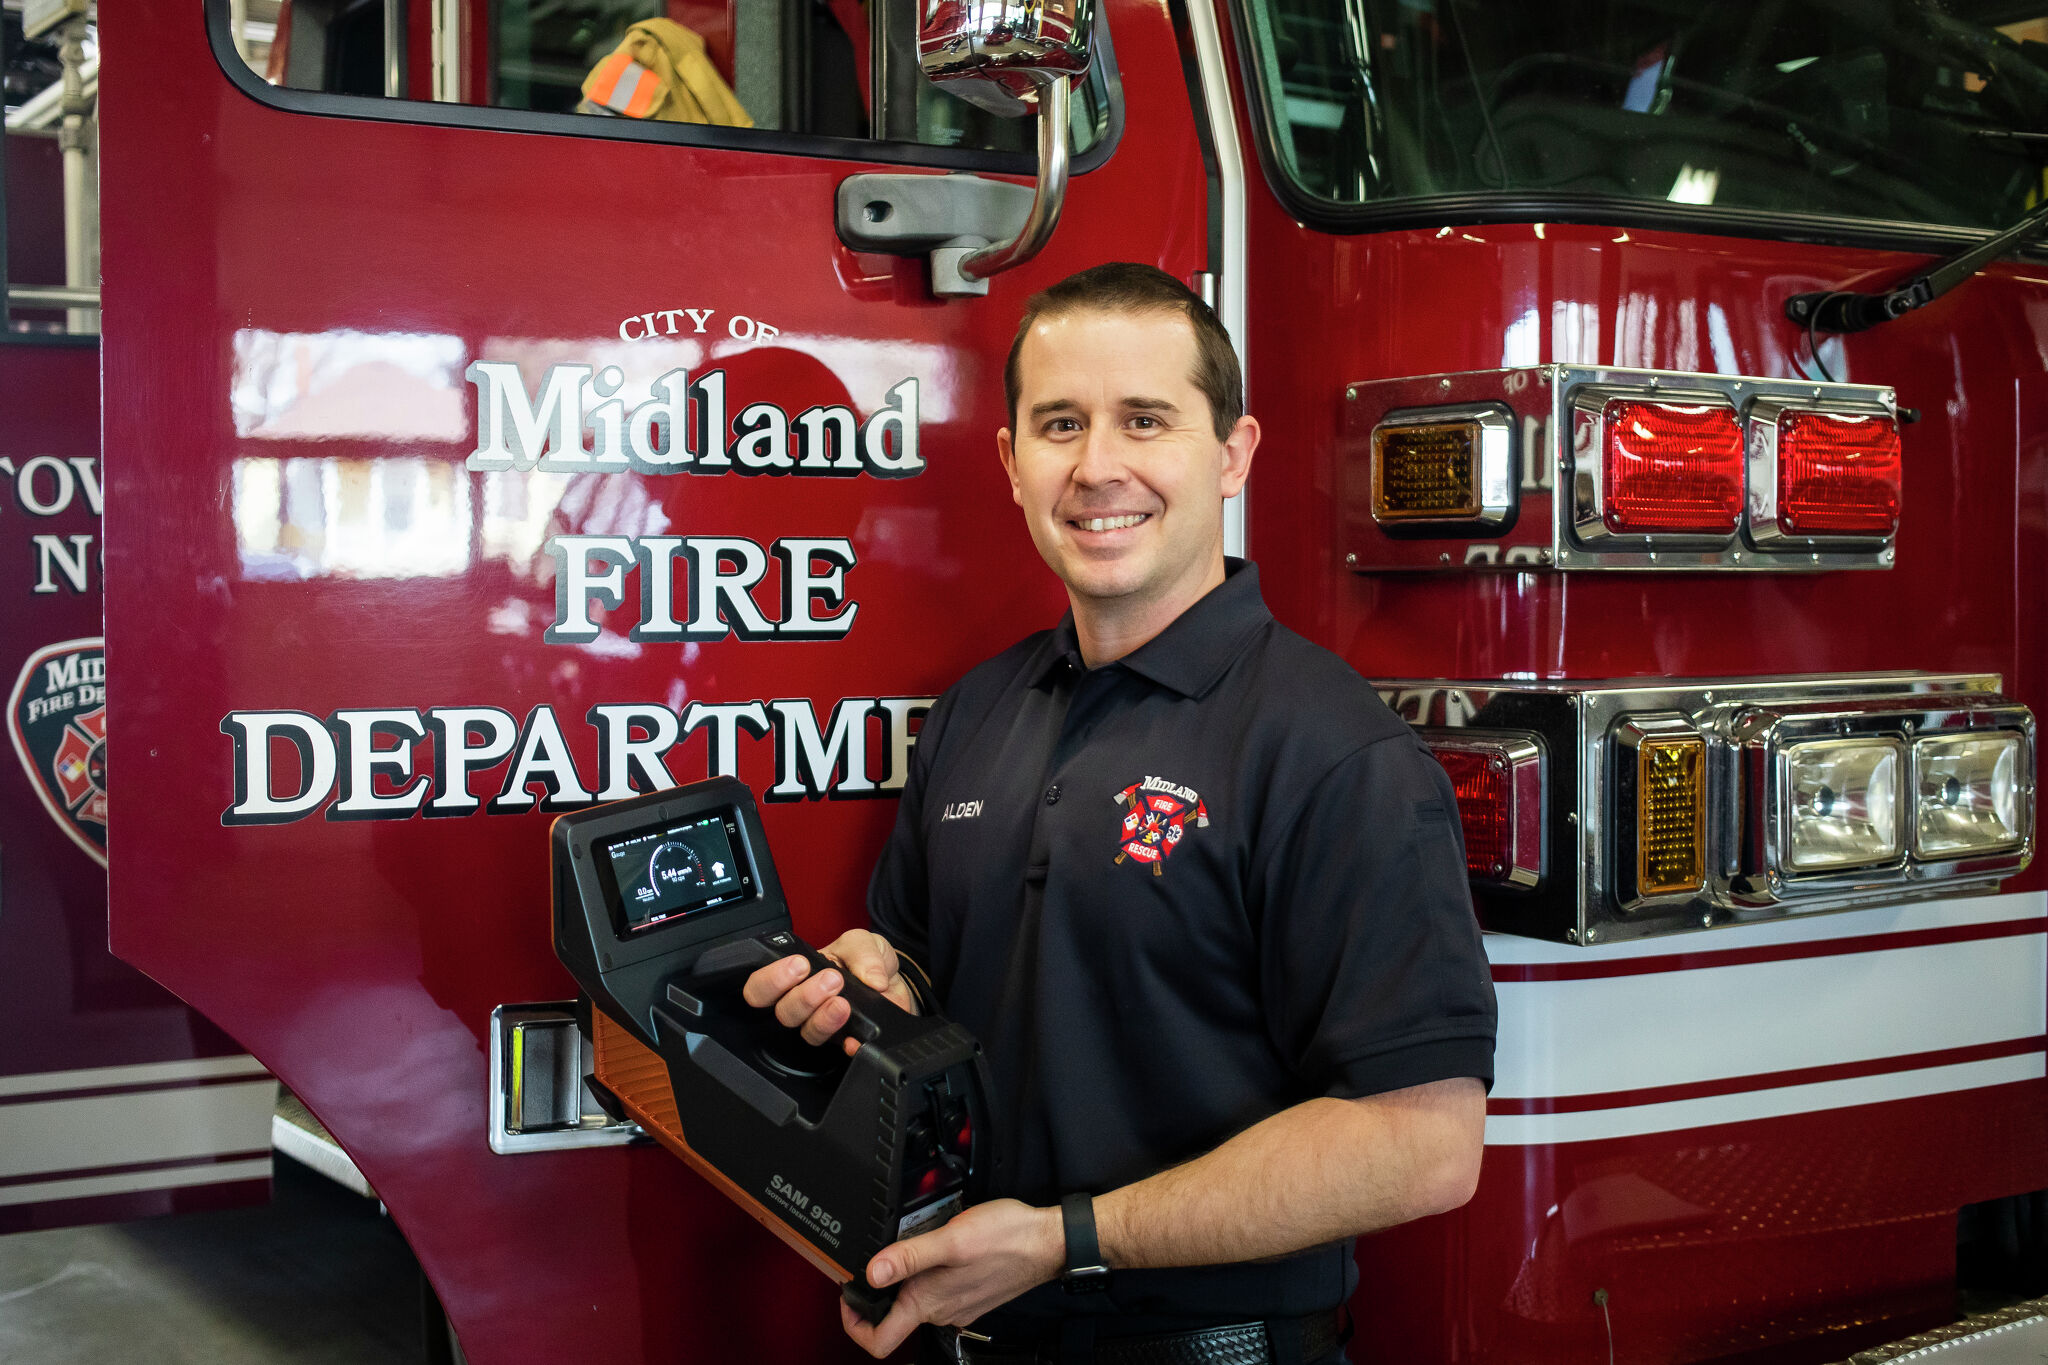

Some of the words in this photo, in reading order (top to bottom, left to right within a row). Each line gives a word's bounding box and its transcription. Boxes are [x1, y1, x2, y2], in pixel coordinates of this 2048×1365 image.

[619, 308, 715, 342] CITY
[728, 315, 779, 345] OF
[466, 360, 927, 479] Midland
[545, 535, 859, 644] FIRE
[27, 691, 75, 724] FIRE
[1140, 775, 1198, 803] MIDLAND
[1154, 799, 1173, 812] FIRE
[941, 799, 984, 822] ALDEN
[1128, 842, 1159, 859] RESCUE
[770, 1174, 809, 1210] SAM
[810, 1204, 841, 1234] 950
